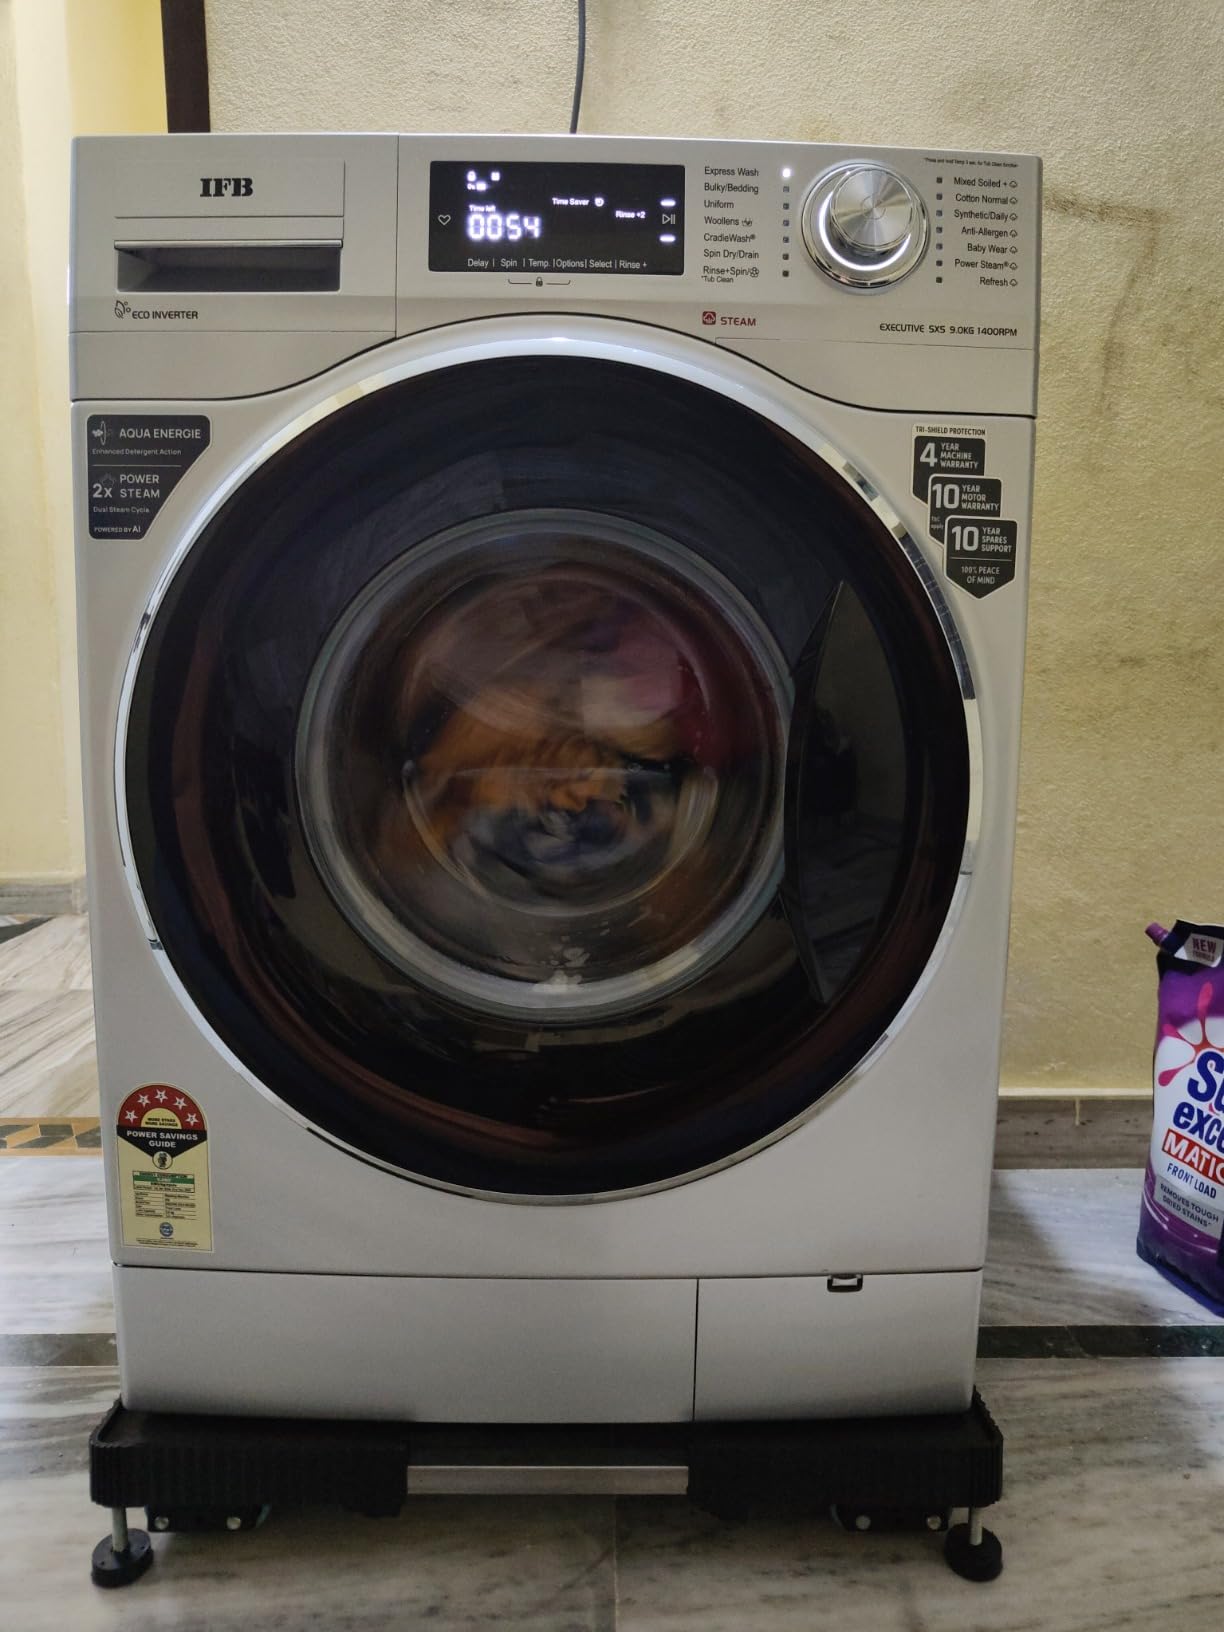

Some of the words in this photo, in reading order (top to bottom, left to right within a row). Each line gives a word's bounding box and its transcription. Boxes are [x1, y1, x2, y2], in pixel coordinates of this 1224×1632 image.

[704, 166, 735, 177] Express
[737, 167, 759, 176] Wash
[200, 177, 253, 197] IFB
[954, 177, 976, 187] Mixed
[978, 178, 1001, 188] Soiled
[704, 183, 759, 195] Bulky/Bedding
[552, 197, 568, 205] Time
[955, 193, 980, 203] Cotton
[981, 195, 1008, 204] Normal
[469, 204, 485, 212] Time
[704, 200, 734, 209] Uniform
[615, 210, 635, 218] Rinse
[954, 209, 1008, 222] Synthetic/Daily
[704, 216, 739, 226] Woollens
[961, 226, 1008, 239] Anti-Allergen
[967, 243, 986, 254] Baby
[987, 244, 1008, 254] Wear
[703, 249, 721, 260] Spin
[723, 250, 759, 260] Dry/Drain
[467, 258, 489, 269] Delay
[500, 258, 517, 269] Spin
[556, 258, 584, 270] Options
[589, 259, 612, 269] Select
[619, 260, 640, 269] Rinse
[954, 258, 978, 268] Power
[979, 277, 1008, 287] Refresh
[132, 310, 150, 320] ECO
[152, 310, 198, 320] INVERTER
[720, 316, 757, 327] STEAM
[880, 323, 925, 333] EXECUTIVE
[950, 326, 974, 335] 9.0KG
[977, 327, 1017, 336] 1400RPM
[120, 428, 151, 439] AQUA
[153, 428, 201, 439] ENERGIE
[916, 426, 948, 434] TRI-SHIELD
[950, 427, 985, 436] PROTECTION
[940, 442, 960, 450] YEAR
[125, 448, 158, 456] Detergent
[919, 442, 938, 468] 4
[940, 451, 972, 460] MACHINE
[940, 460, 978, 469] WARRANTY
[120, 474, 160, 484] POWER
[120, 488, 160, 498] STEAM
[962, 484, 981, 492] YEAR
[932, 483, 960, 509] 10
[961, 493, 986, 502] MOTOR
[131, 506, 150, 514] Cycle
[961, 502, 999, 511] WARRANTY
[982, 527, 1001, 535] YEAR
[951, 526, 979, 551] 10
[982, 535, 1007, 544] SPARES
[981, 544, 1012, 553] SUPPORT
[978, 566, 1000, 574] PEACE
[967, 576, 977, 584] OF
[978, 576, 996, 585] MIND
[1192, 937, 1217, 954] NEW
[126, 1130, 157, 1138] POWER
[159, 1132, 198, 1141] SAVINGS
[149, 1140, 176, 1148] GUIDE
[1167, 1162, 1194, 1185] FRONT
[1194, 1181, 1217, 1199] LOAD
[1160, 1183, 1190, 1207] REMOVES
[1191, 1202, 1219, 1223] TOUGH
